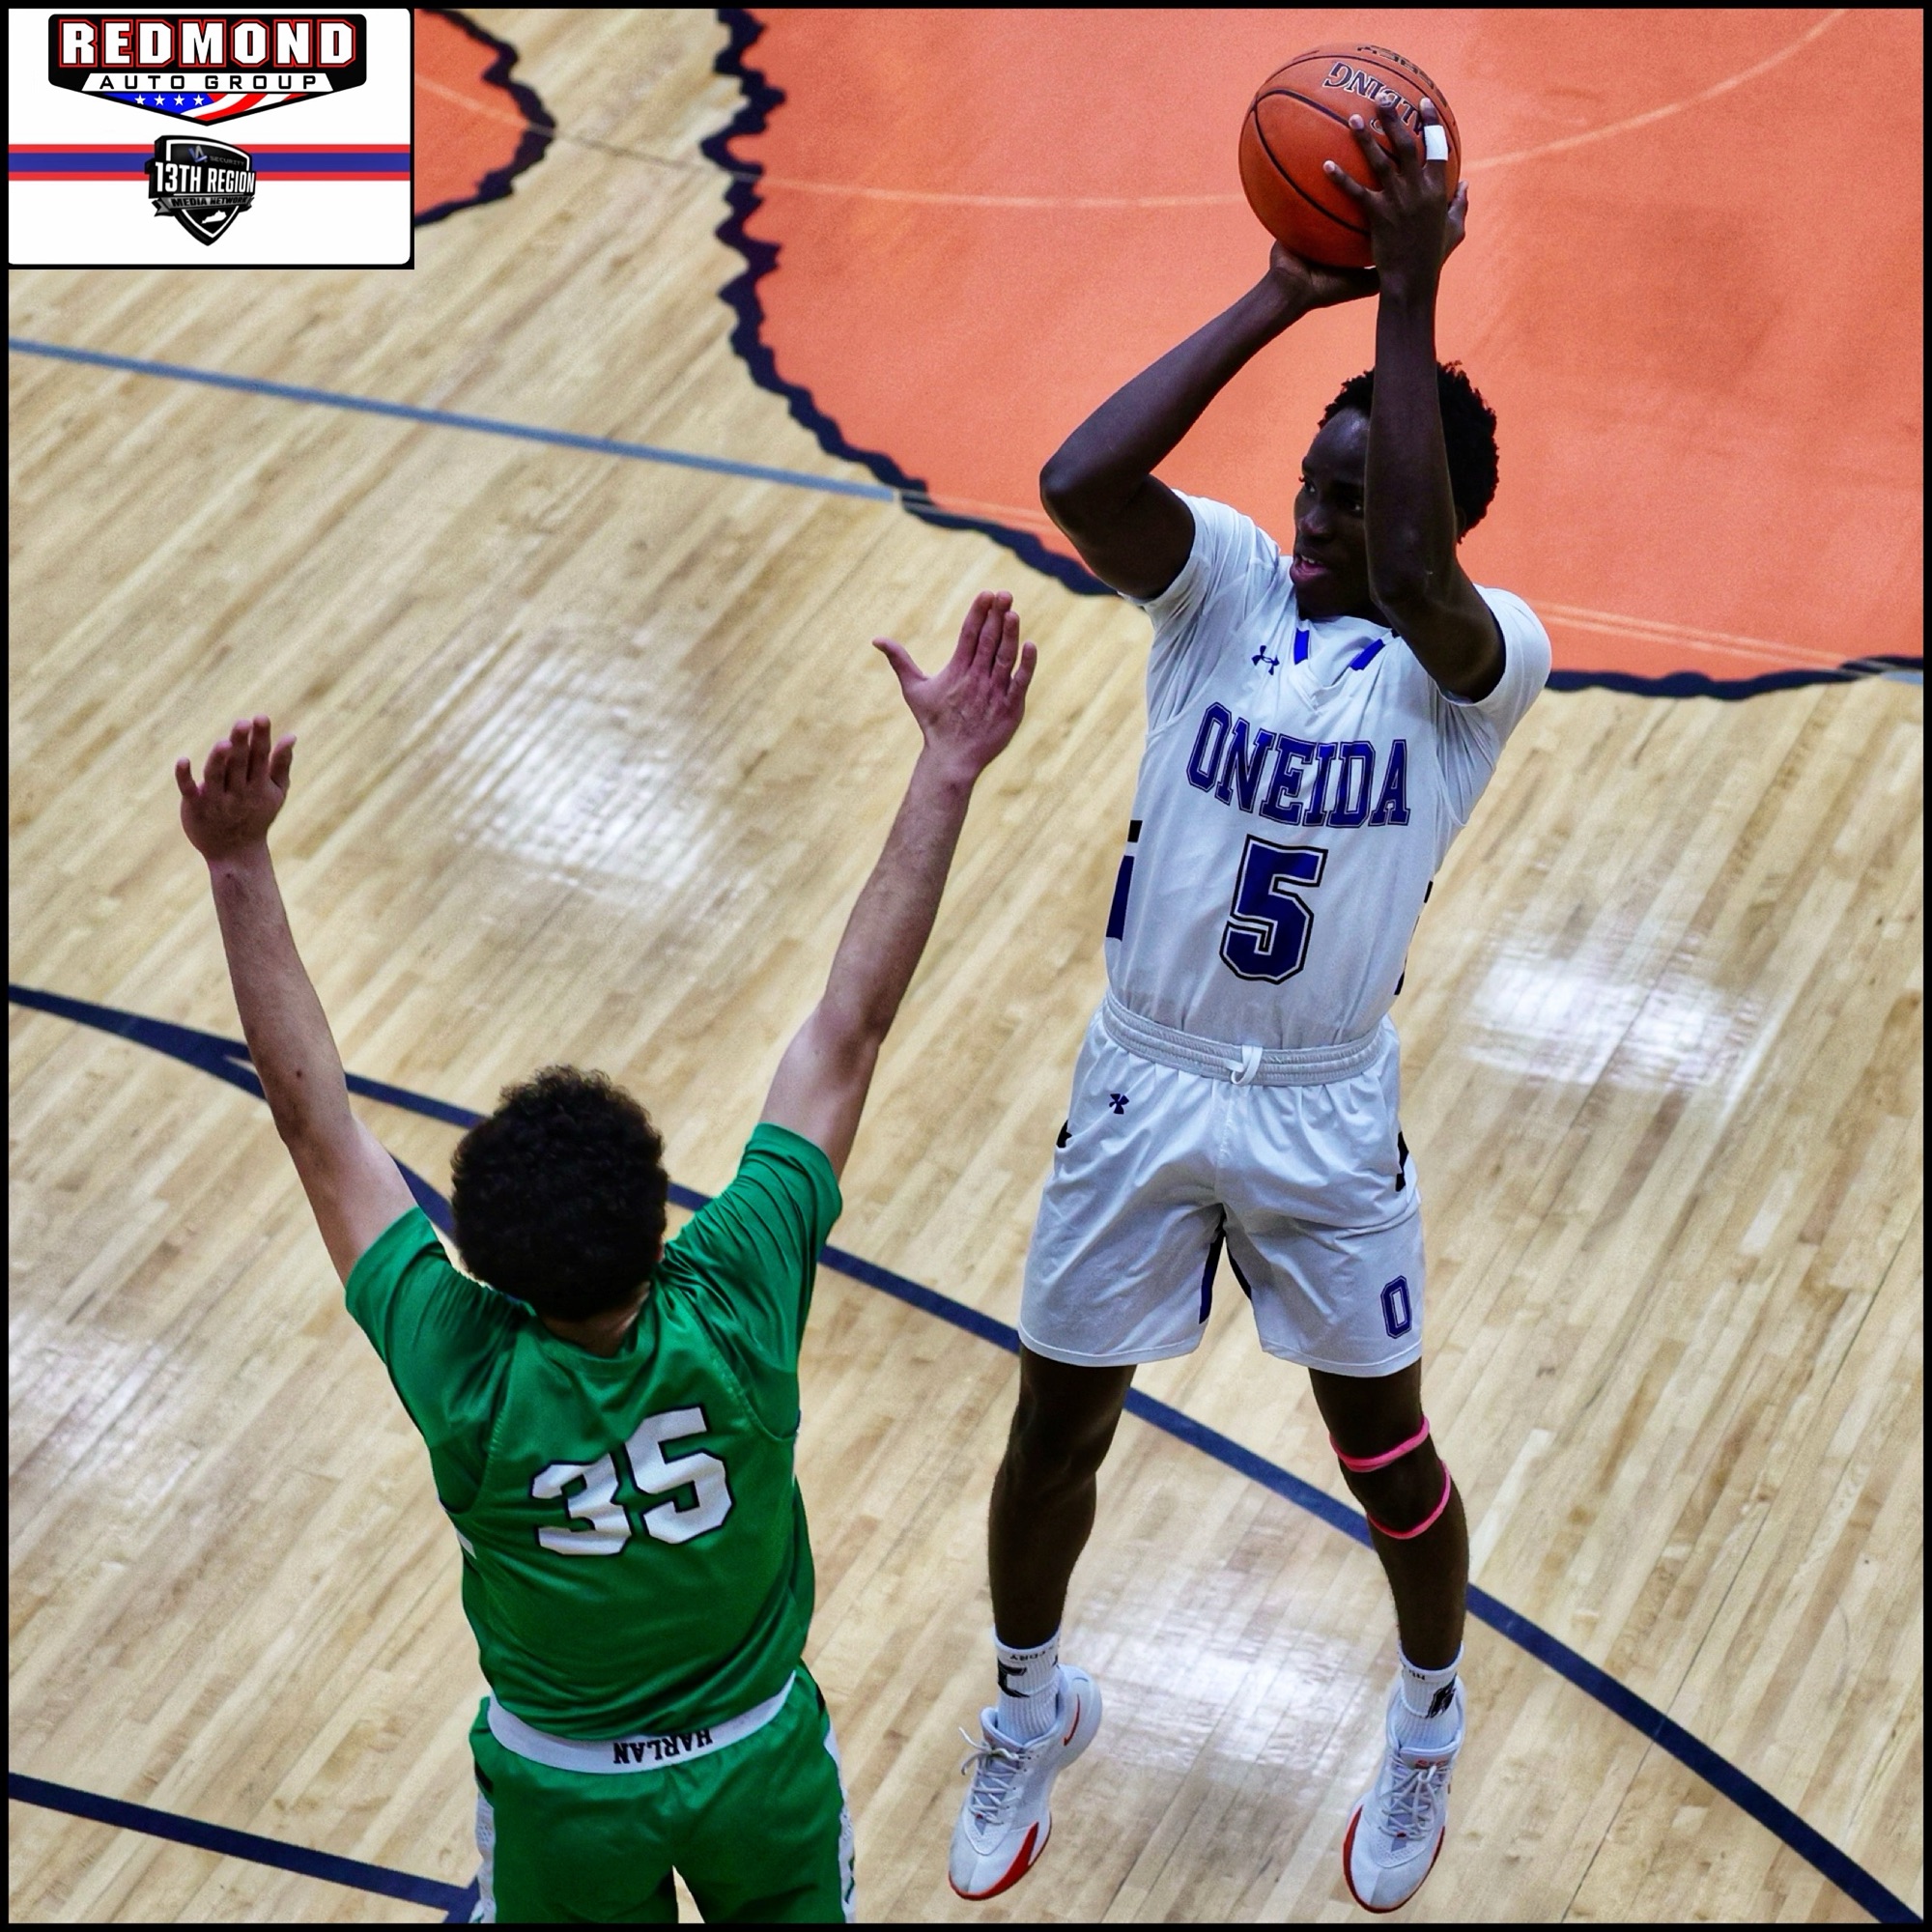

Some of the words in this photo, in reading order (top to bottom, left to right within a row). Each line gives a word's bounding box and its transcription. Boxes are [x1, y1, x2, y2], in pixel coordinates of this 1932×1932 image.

[1186, 701, 1411, 829] ONEIDA
[1219, 834, 1329, 985] 5
[530, 1406, 733, 1556] 35
[613, 1728, 713, 1764] HARLAN
